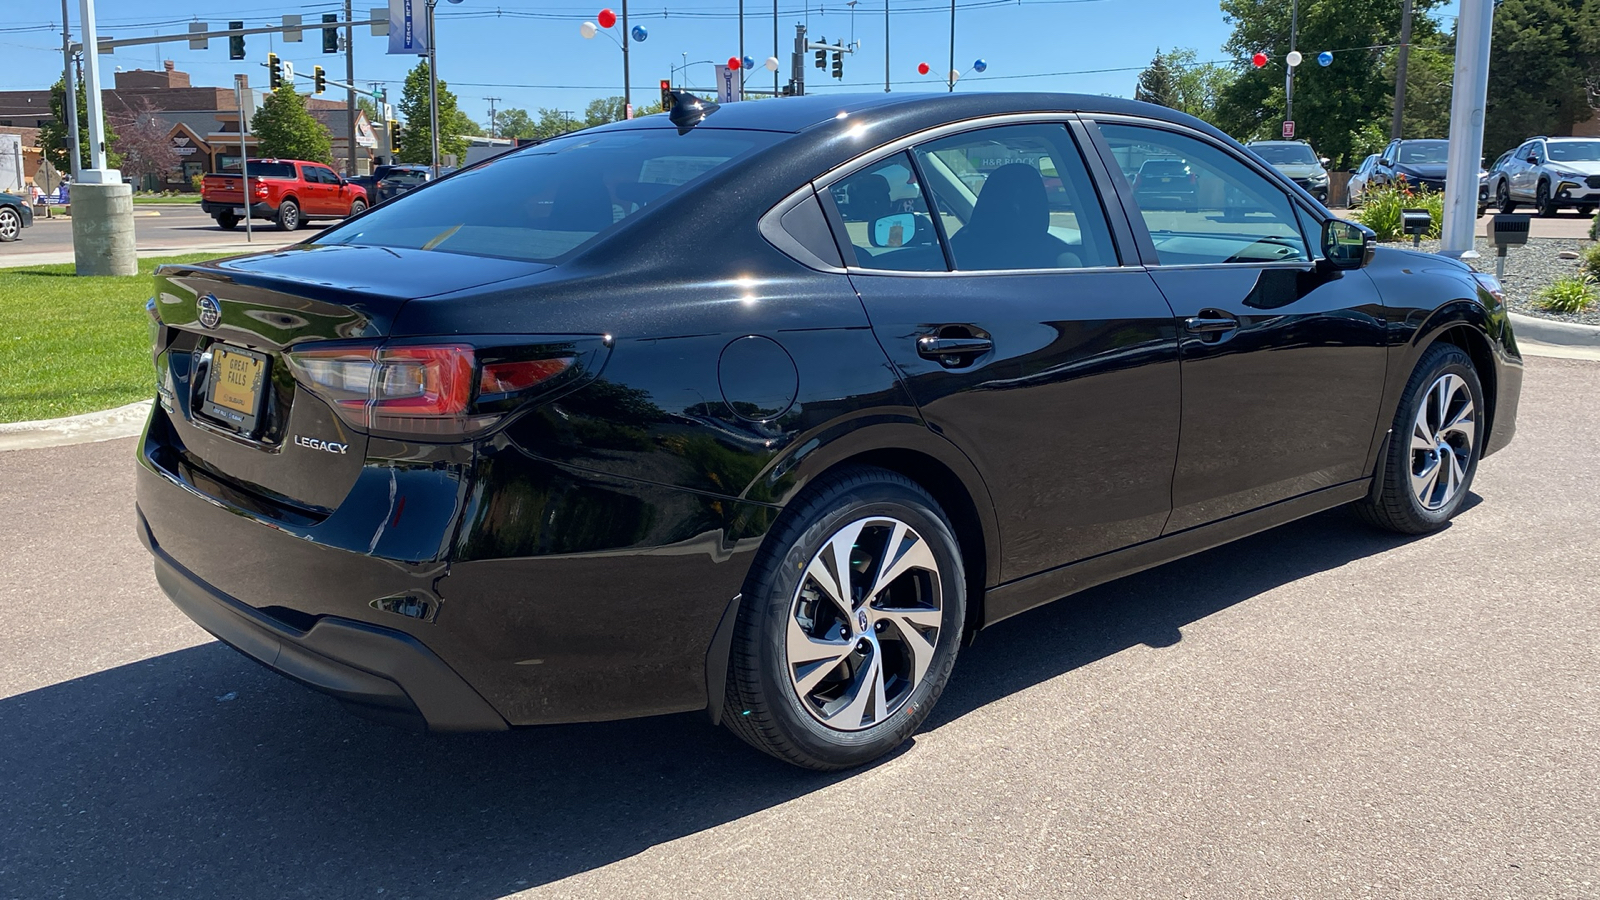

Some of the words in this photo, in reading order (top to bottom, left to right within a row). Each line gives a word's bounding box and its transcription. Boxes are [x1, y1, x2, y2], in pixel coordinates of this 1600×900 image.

[982, 158, 1002, 166] H&R
[230, 359, 249, 373] GREAT
[227, 371, 247, 386] FALLS
[294, 434, 349, 454] LEGACY
[894, 649, 957, 740] YOKOHAMA
